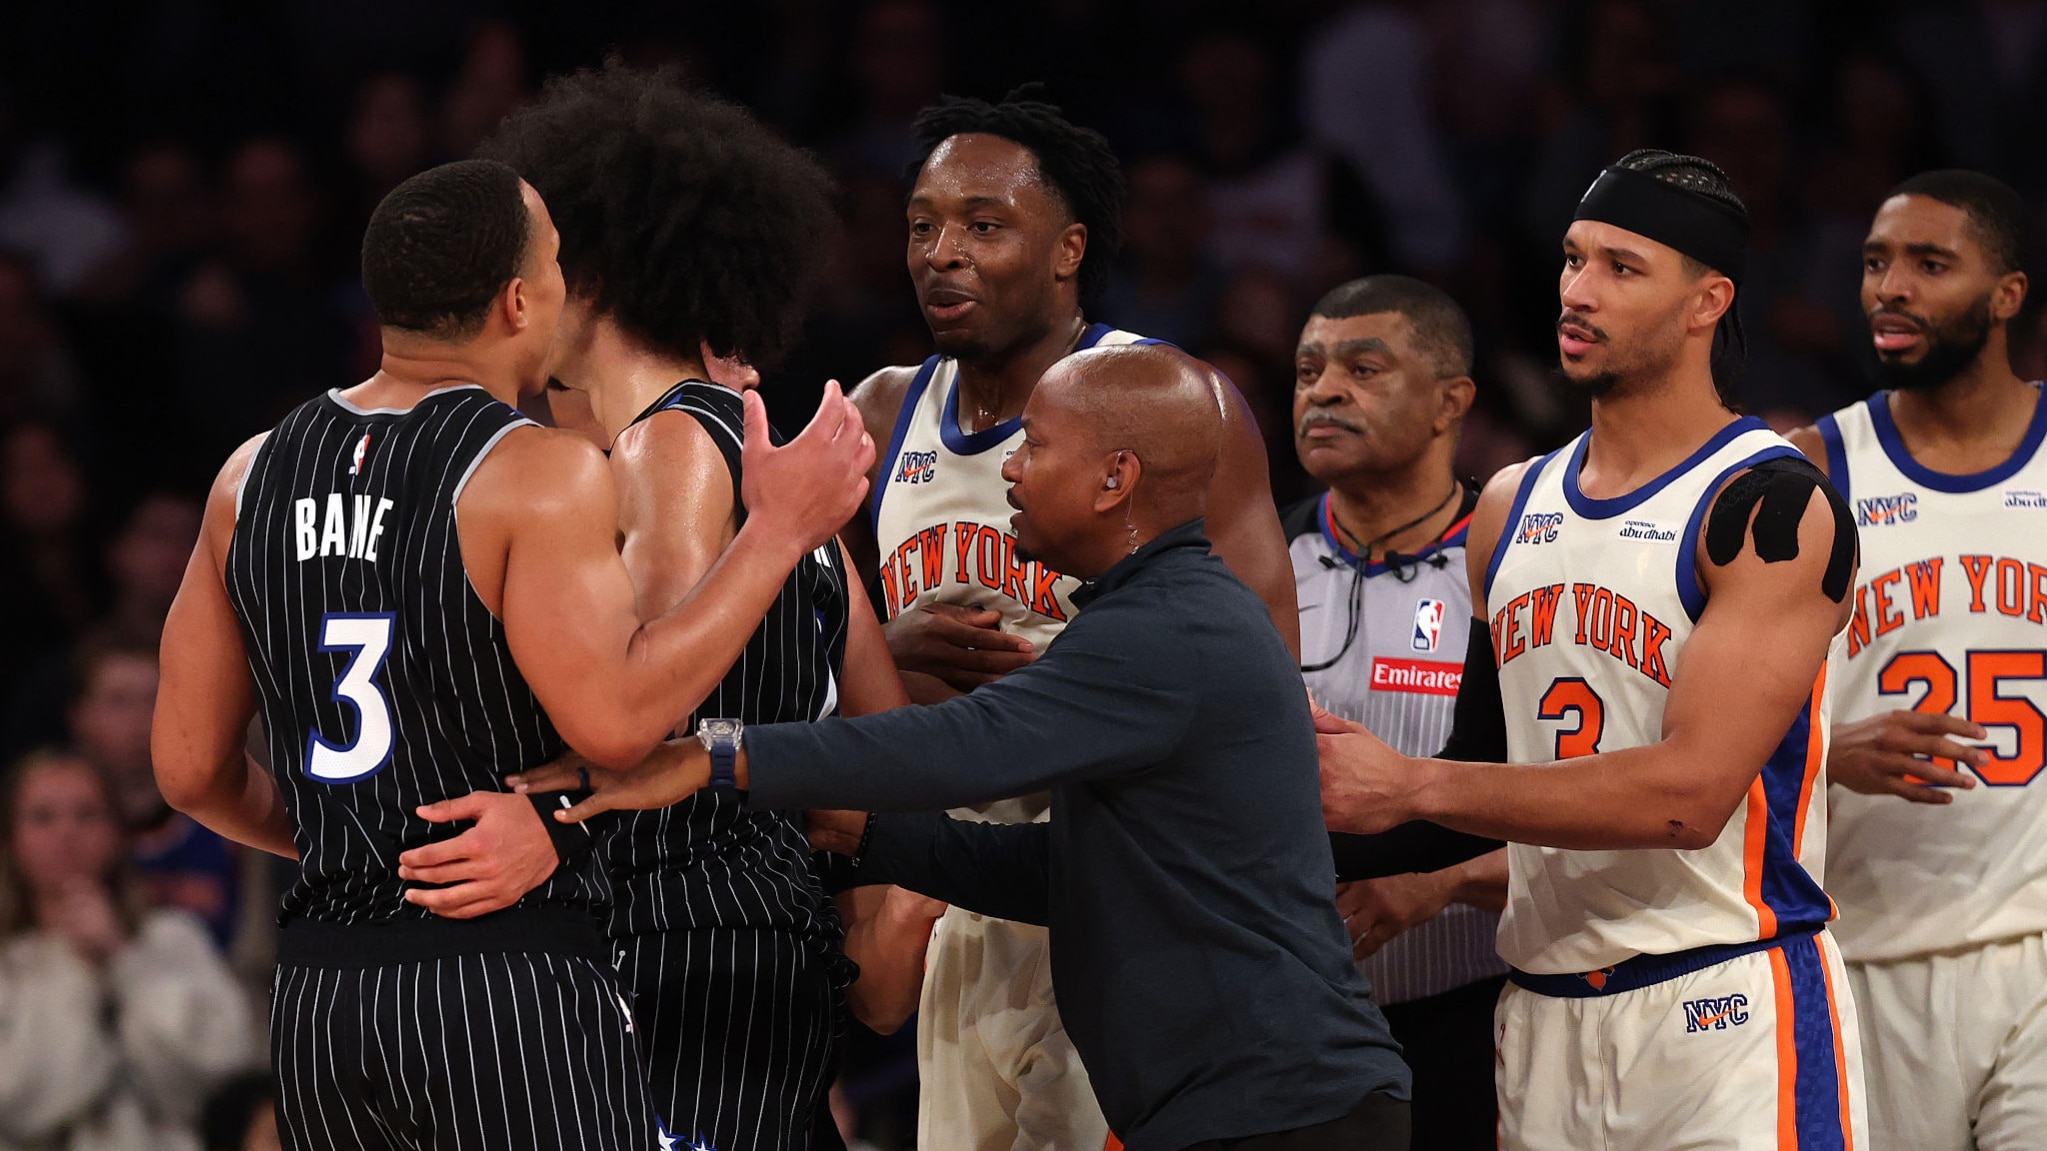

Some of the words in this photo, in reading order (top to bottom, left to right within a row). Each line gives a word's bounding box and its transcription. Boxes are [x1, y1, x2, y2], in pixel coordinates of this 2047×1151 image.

[895, 450, 937, 484] NYC
[295, 493, 394, 562] BANE
[1516, 512, 1564, 545] NYC
[1619, 526, 1643, 539] abu
[1643, 529, 1678, 541] dhabi
[1857, 493, 1918, 527] NYC
[880, 523, 948, 621] NEW
[953, 521, 1067, 623] YORK
[1846, 556, 1944, 660] NEW
[1958, 554, 2047, 625] YOR
[1490, 583, 1566, 671] NEW
[1572, 582, 1672, 690] YORK
[303, 611, 397, 785] 3
[1536, 676, 1605, 761] 3
[1877, 649, 2047, 788] 25
[1682, 993, 1750, 1034] NYC
